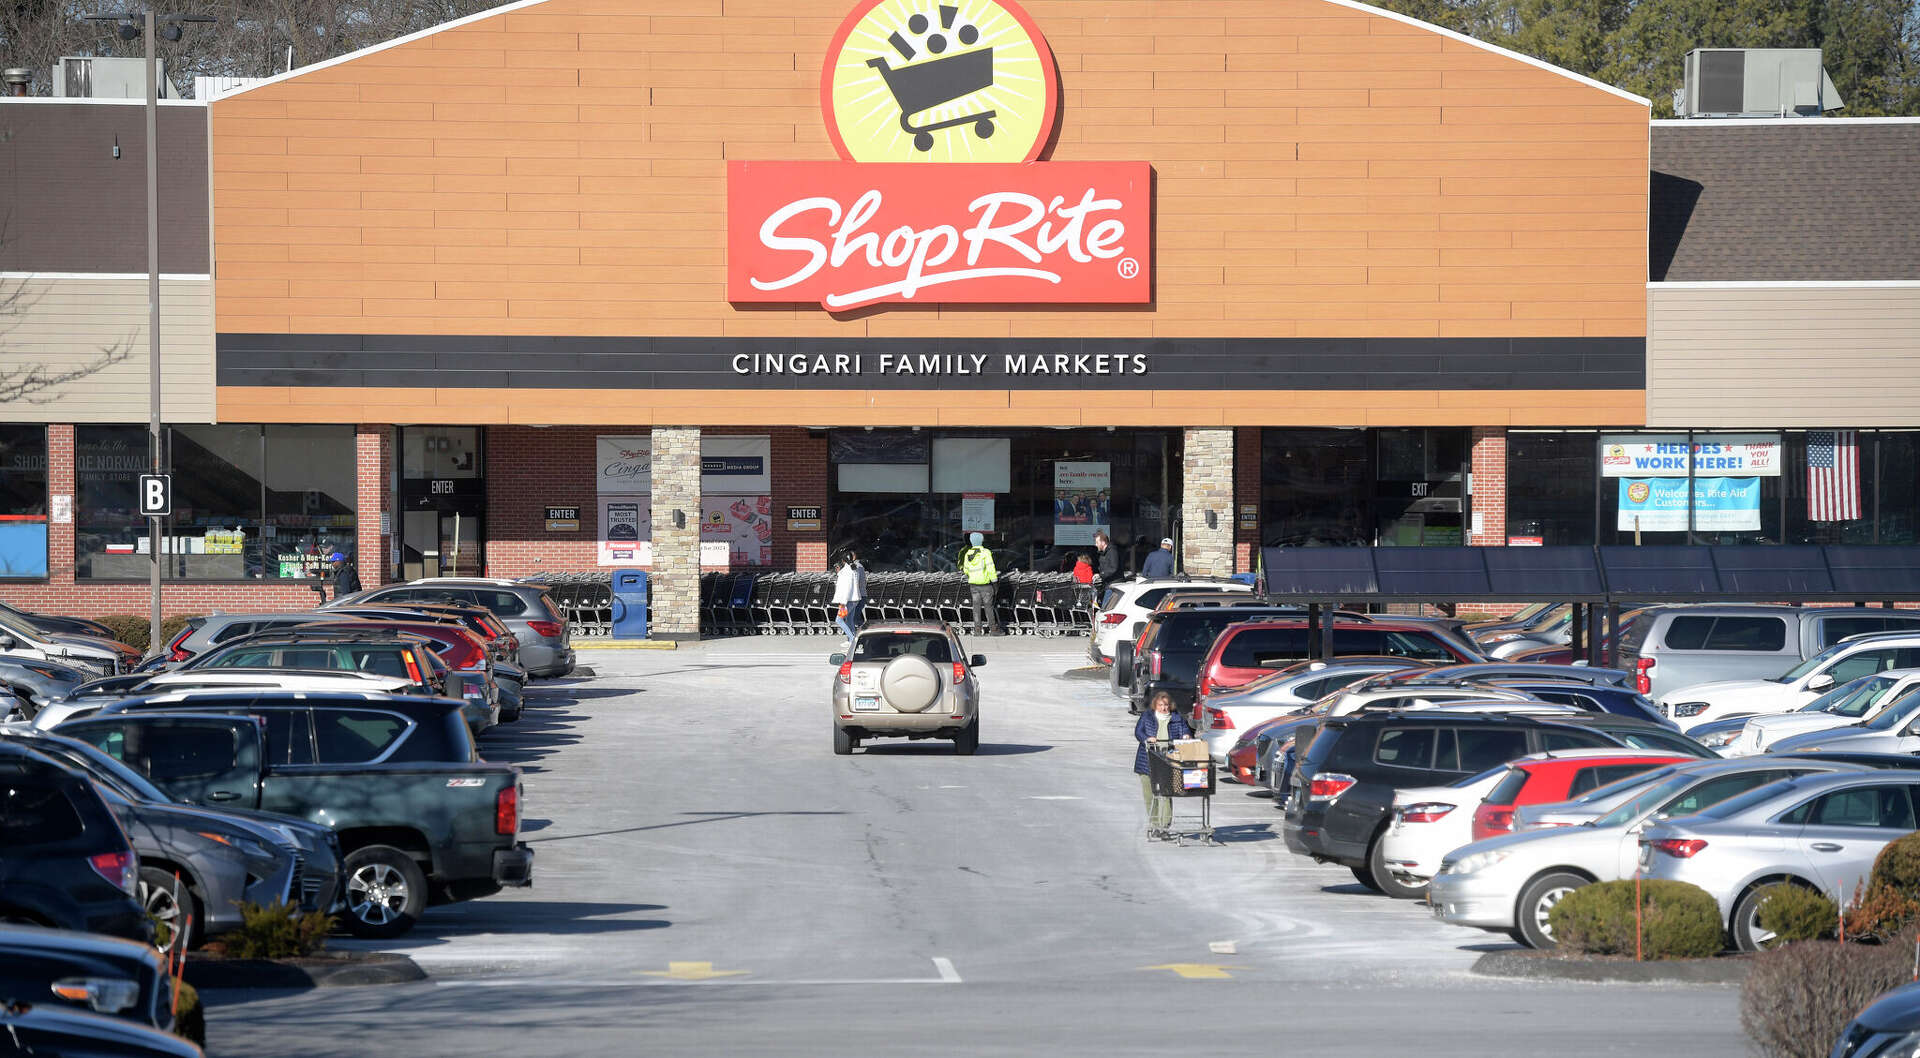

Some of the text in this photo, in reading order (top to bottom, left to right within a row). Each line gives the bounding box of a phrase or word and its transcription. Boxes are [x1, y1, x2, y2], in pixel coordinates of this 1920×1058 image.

[750, 187, 1125, 299] ShopRite
[732, 353, 1148, 375] CINGARI FAMILY MARKETS
[1656, 442, 1722, 455] HEROES
[1744, 441, 1776, 451] THANK
[96, 455, 149, 471] NORWAL
[1635, 457, 1686, 469] WORK
[1693, 457, 1743, 469] HERE!
[1750, 458, 1770, 466] ALL!
[604, 462, 651, 479] Cinga
[431, 480, 454, 494] ENTER
[1411, 483, 1428, 497] EXIT
[1707, 488, 1728, 498] Rite
[1729, 487, 1747, 498] Aid
[146, 479, 164, 510] B
[1655, 498, 1716, 508] Customrs...
[549, 509, 575, 519] ENTER
[791, 509, 817, 519] ENTER
